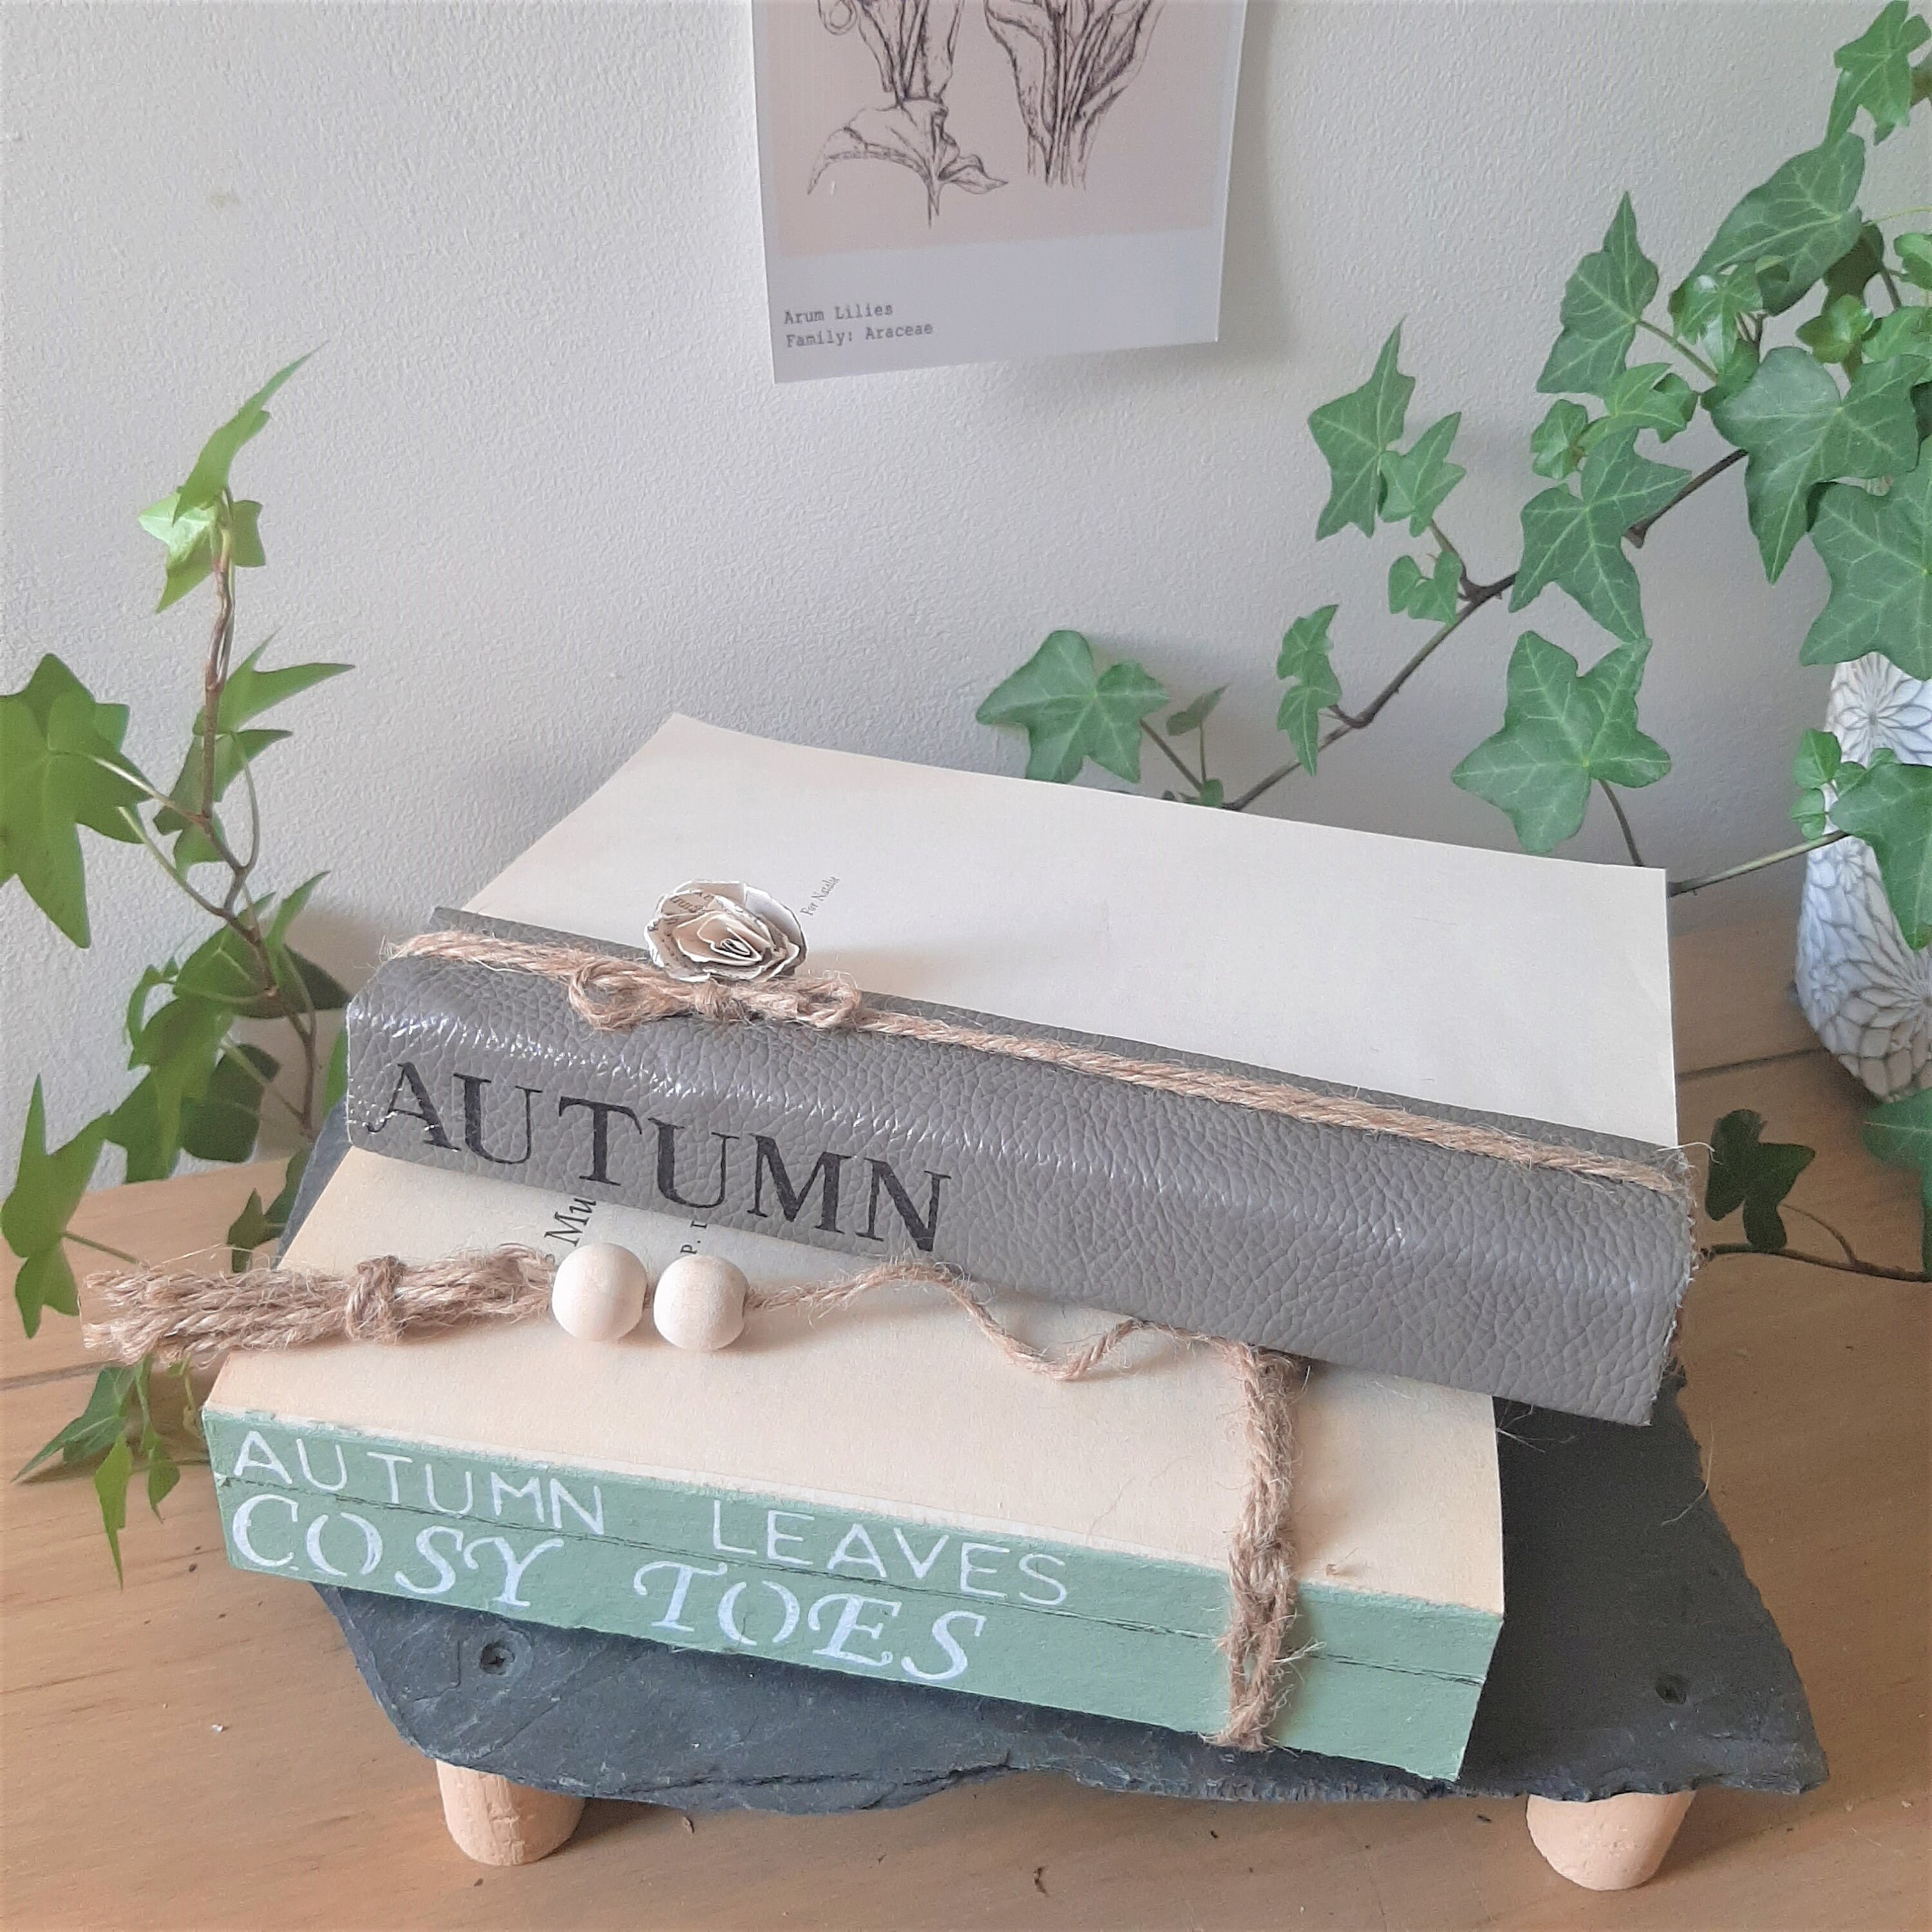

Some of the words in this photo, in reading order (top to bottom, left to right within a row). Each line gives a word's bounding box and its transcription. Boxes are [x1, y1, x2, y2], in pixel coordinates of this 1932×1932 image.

[784, 309, 824, 325] Arum
[835, 303, 893, 319] Lilies
[786, 329, 853, 348] Family:
[865, 323, 933, 341] Araceae
[800, 902, 819, 916] For
[366, 1061, 951, 1252] AUTUMN
[233, 1430, 604, 1535] AUTUMN
[713, 1499, 1068, 1605] LEAVES
[232, 1493, 565, 1607] COSY
[633, 1560, 987, 1681] TOES
